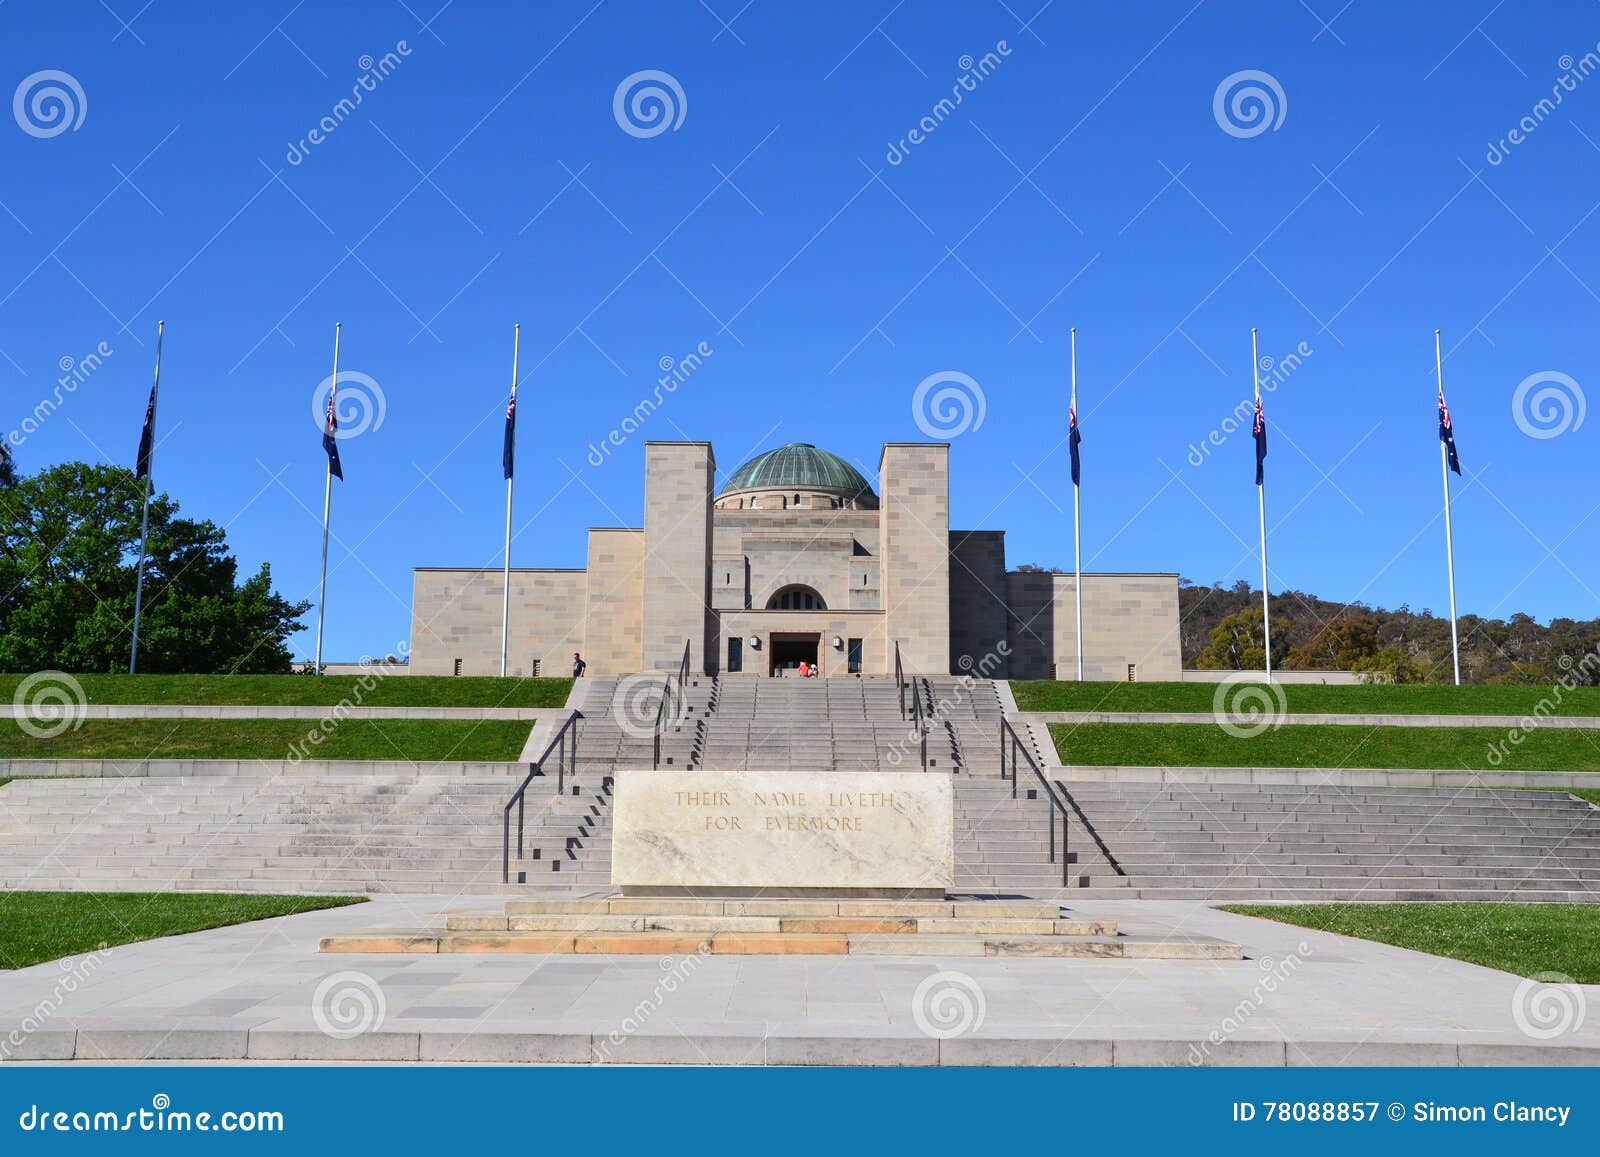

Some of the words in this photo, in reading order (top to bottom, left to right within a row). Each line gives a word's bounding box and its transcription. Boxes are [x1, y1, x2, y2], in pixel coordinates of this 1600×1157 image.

[675, 791, 731, 806] THEIR
[754, 792, 806, 807] NAME
[829, 792, 895, 808] LIVETH
[704, 816, 742, 831] FOR
[765, 816, 864, 832] EVERMORE
